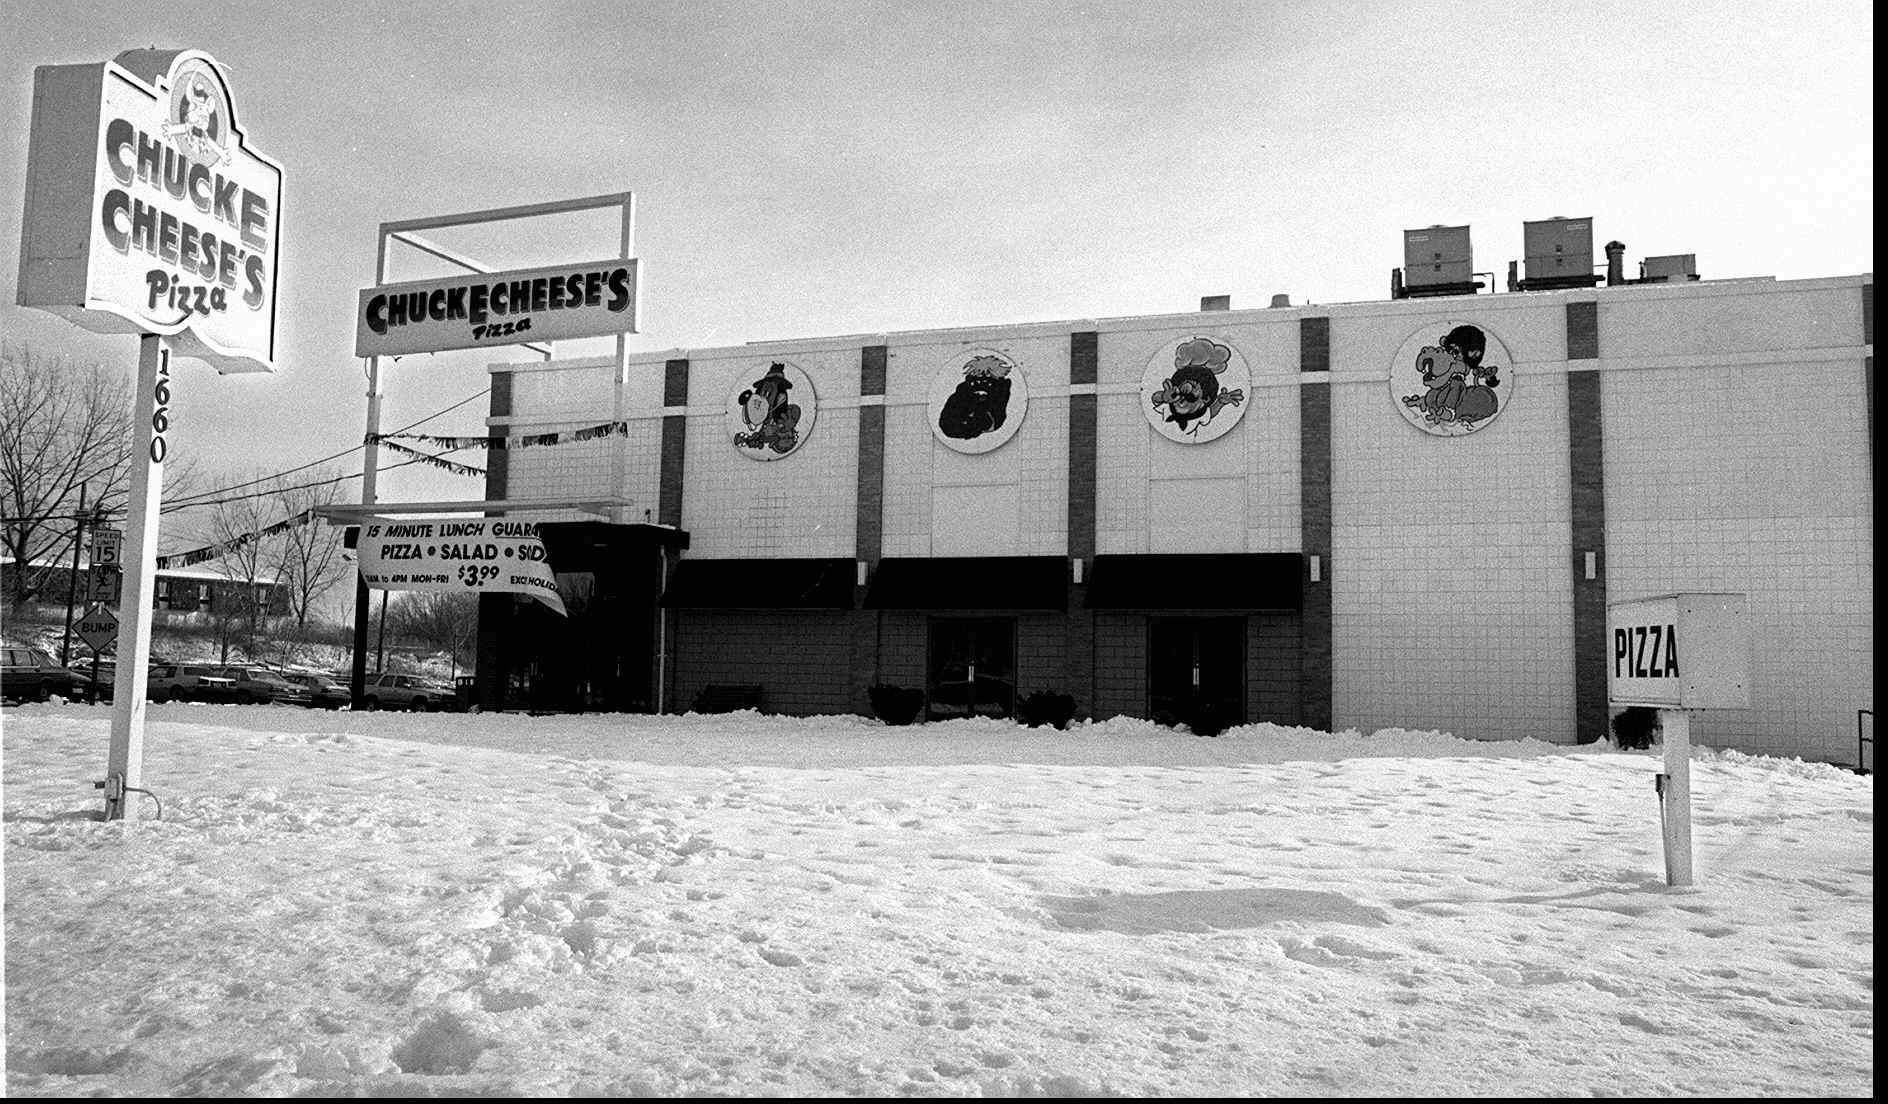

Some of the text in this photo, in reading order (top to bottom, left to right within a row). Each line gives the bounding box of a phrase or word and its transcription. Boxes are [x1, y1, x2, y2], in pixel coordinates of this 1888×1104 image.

[102, 189, 265, 311] CHEESE'S
[146, 269, 227, 316] Pizza
[472, 317, 532, 340] Pizza
[150, 349, 170, 463] 1660
[366, 525, 381, 537] 15
[384, 525, 433, 537] MINUTE
[439, 523, 486, 537] LUNCH
[96, 546, 115, 562] 15
[381, 544, 423, 560] PIZZA
[440, 543, 498, 560] SALAD
[391, 574, 408, 582] 4PM
[411, 574, 449, 583] MON-FRI
[458, 565, 500, 587] $3.99
[81, 622, 116, 633] BUMP
[1615, 624, 1680, 678] PIZZA
